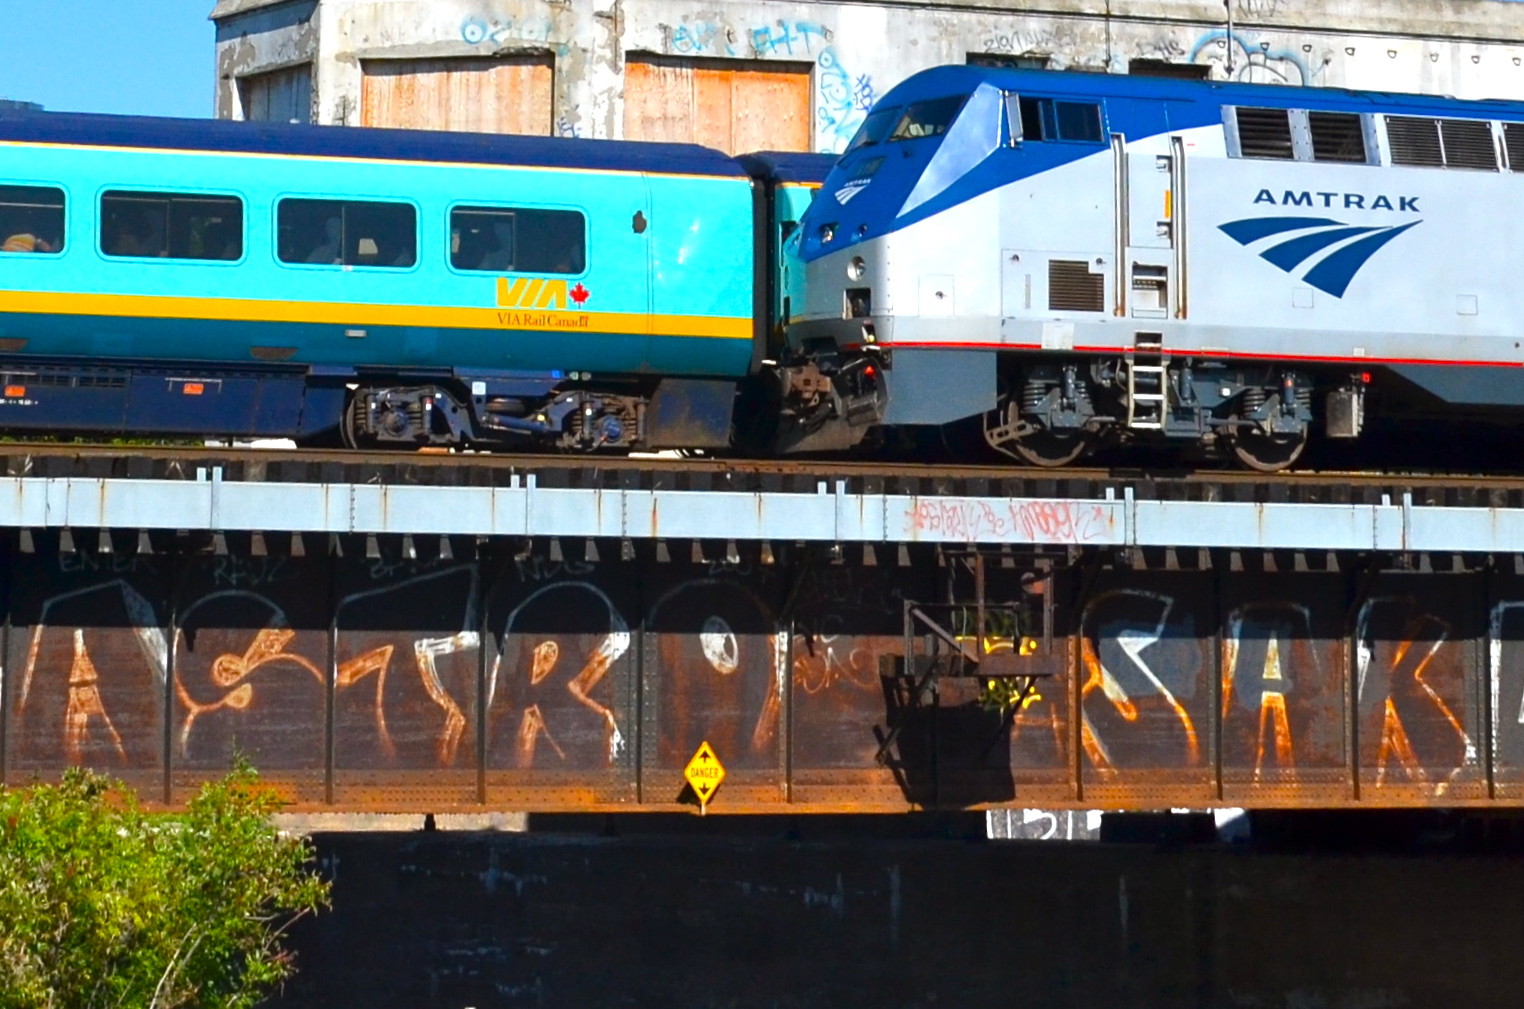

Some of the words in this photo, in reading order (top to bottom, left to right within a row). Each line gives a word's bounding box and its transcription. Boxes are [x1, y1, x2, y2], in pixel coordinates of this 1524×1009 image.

[1253, 188, 1420, 213] AMTRAK
[497, 277, 567, 309] VIA
[498, 312, 520, 326] VIA
[523, 313, 546, 327] Rail
[690, 767, 719, 779] DANGER
